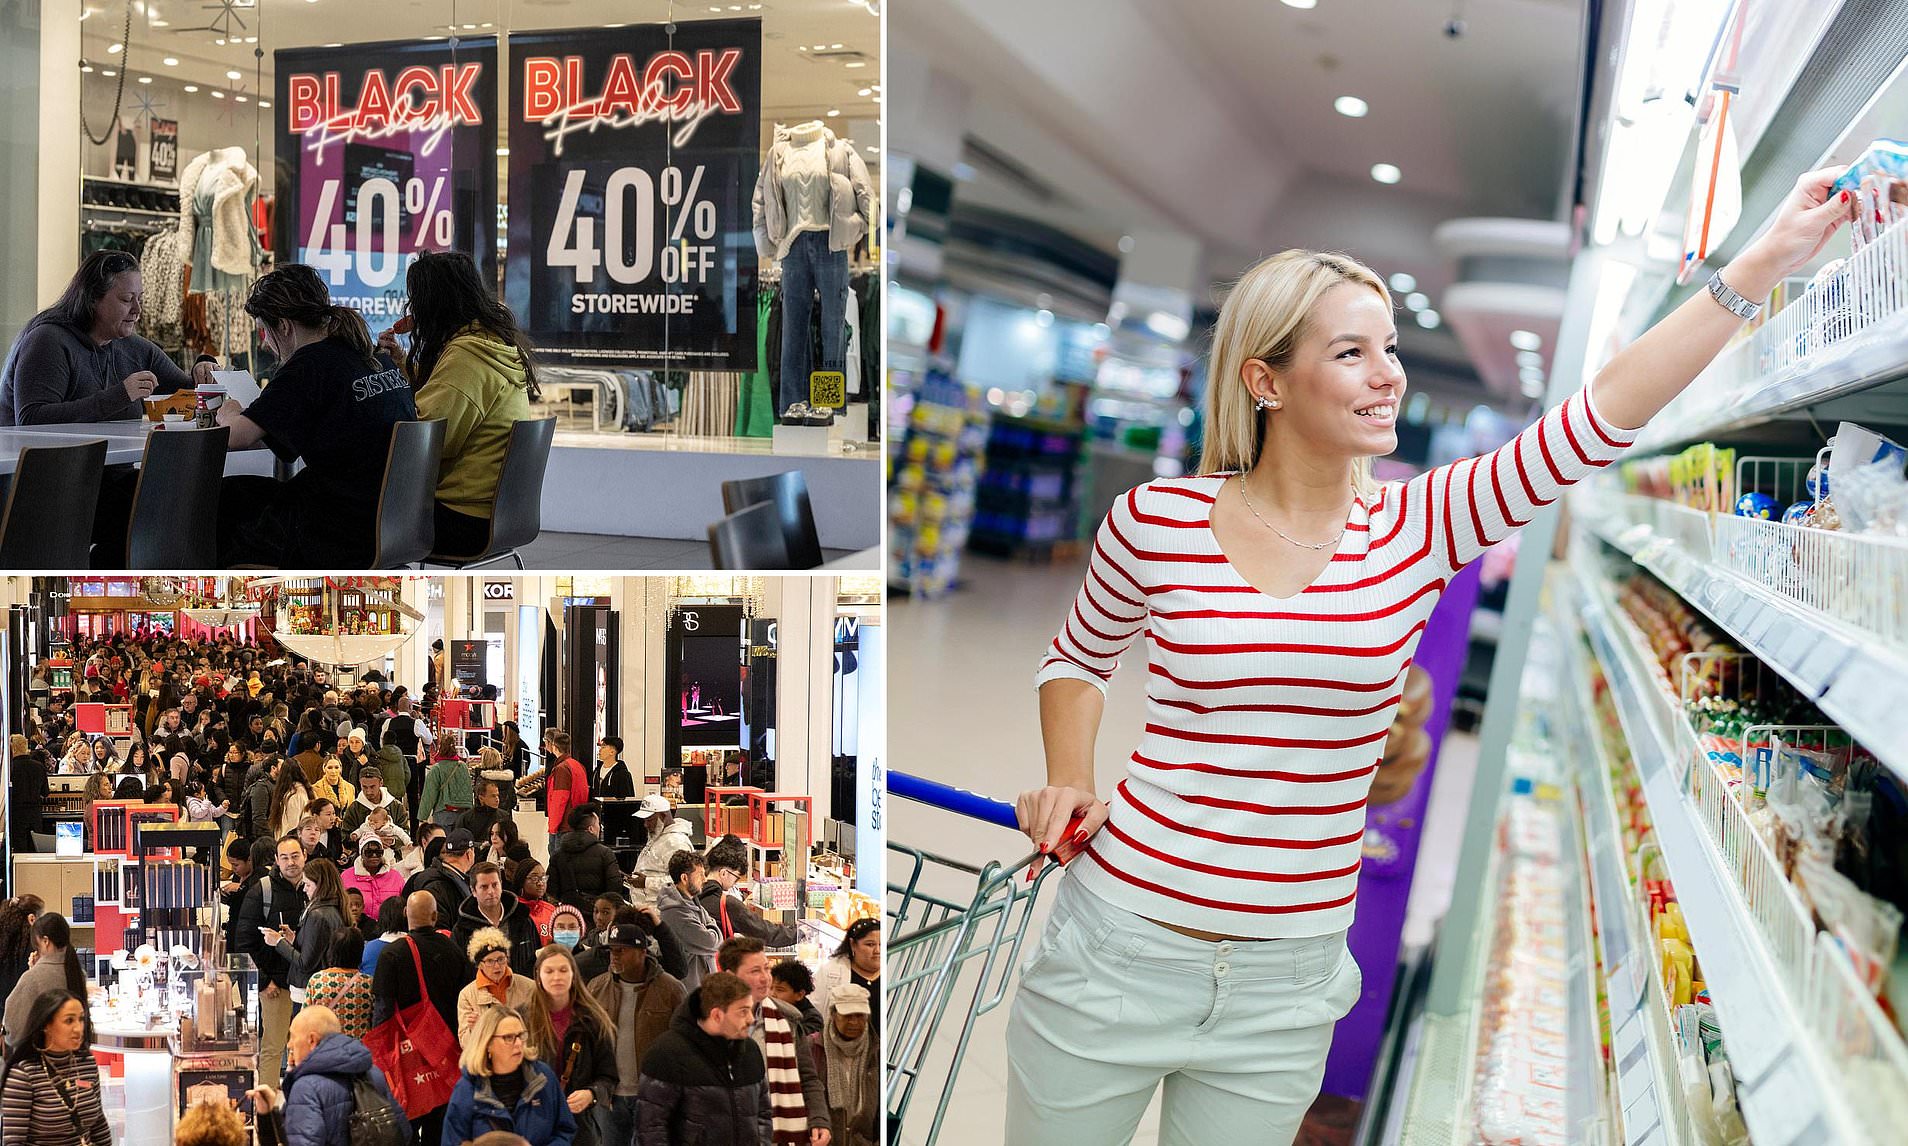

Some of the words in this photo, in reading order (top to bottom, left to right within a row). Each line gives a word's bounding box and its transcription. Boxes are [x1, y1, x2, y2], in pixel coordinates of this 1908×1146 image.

[289, 63, 482, 133] BLACK
[523, 48, 743, 122] BLACK
[542, 80, 720, 157] Friday
[306, 93, 461, 166] Friday
[304, 176, 454, 288] 40%
[546, 165, 717, 285] 40%
[660, 246, 716, 284] OFF
